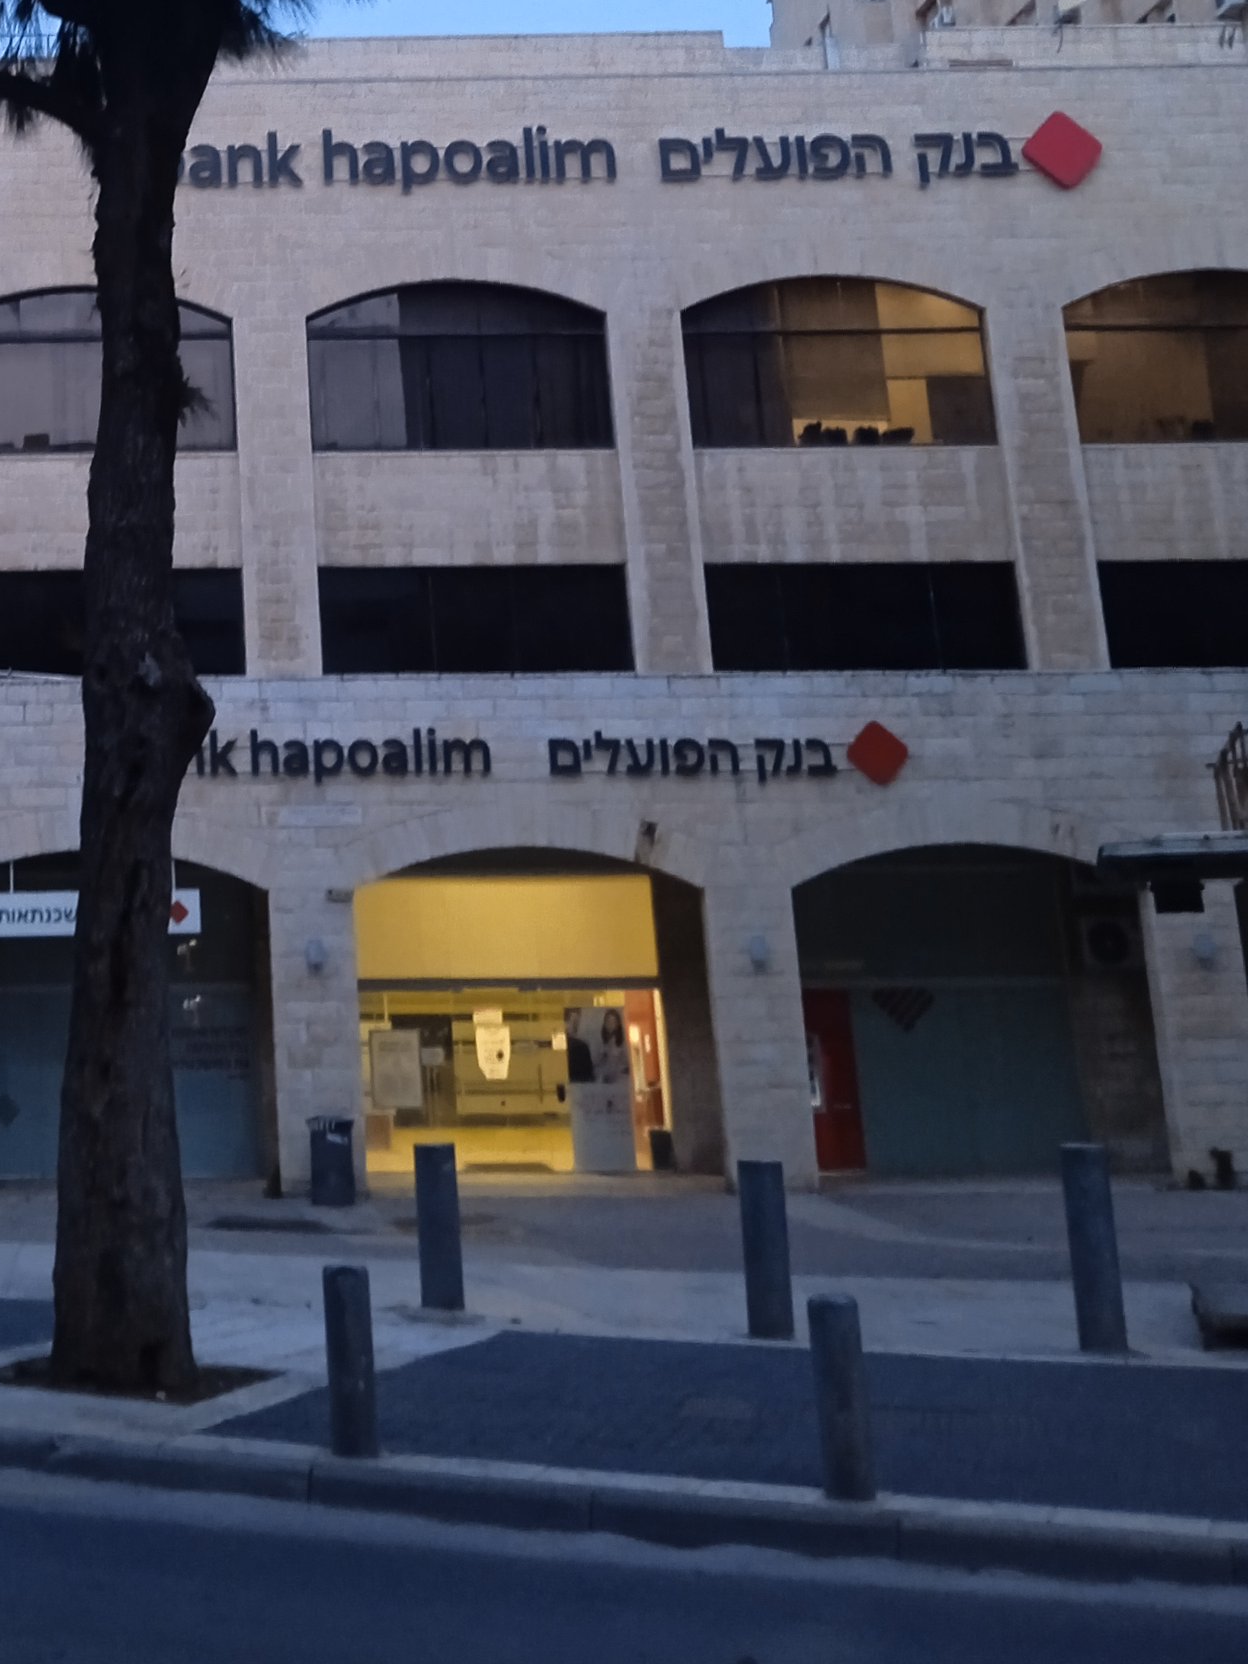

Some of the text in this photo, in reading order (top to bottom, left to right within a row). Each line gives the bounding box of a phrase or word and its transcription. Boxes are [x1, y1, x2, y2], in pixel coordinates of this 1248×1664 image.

[177, 125, 617, 195] ank hapoalim
[658, 128, 1019, 189] בנק הפועלים
[249, 727, 492, 785] hapoalim
[548, 730, 837, 786] בנק הפועלים
